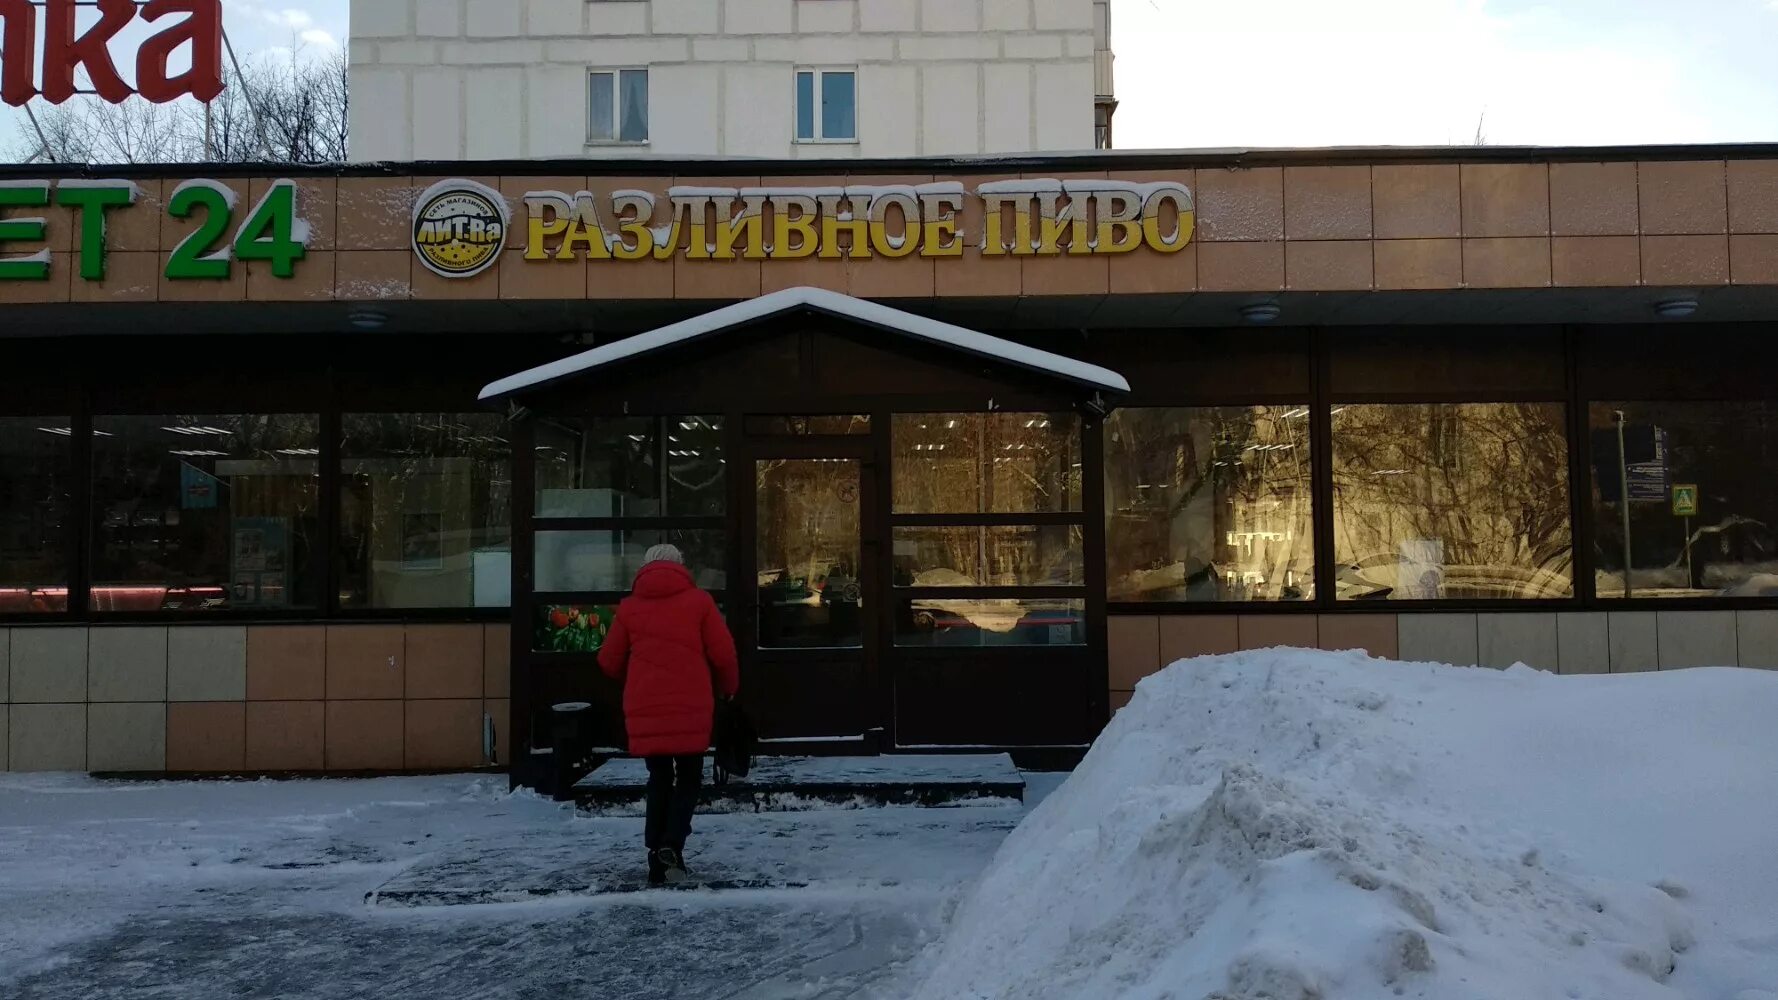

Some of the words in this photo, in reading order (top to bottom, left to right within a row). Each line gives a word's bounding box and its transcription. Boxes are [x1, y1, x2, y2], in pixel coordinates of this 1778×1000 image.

[429, 202, 445, 217] СЕТЬ
[446, 197, 489, 216] МАГАЗИНОВ
[523, 191, 963, 260] РАЗЛИВНОЕ
[980, 188, 1196, 256] ПИВО
[165, 184, 305, 279] 24
[428, 247, 472, 266] РАЗЛИВНОГО
[472, 246, 489, 262] ПИВА
